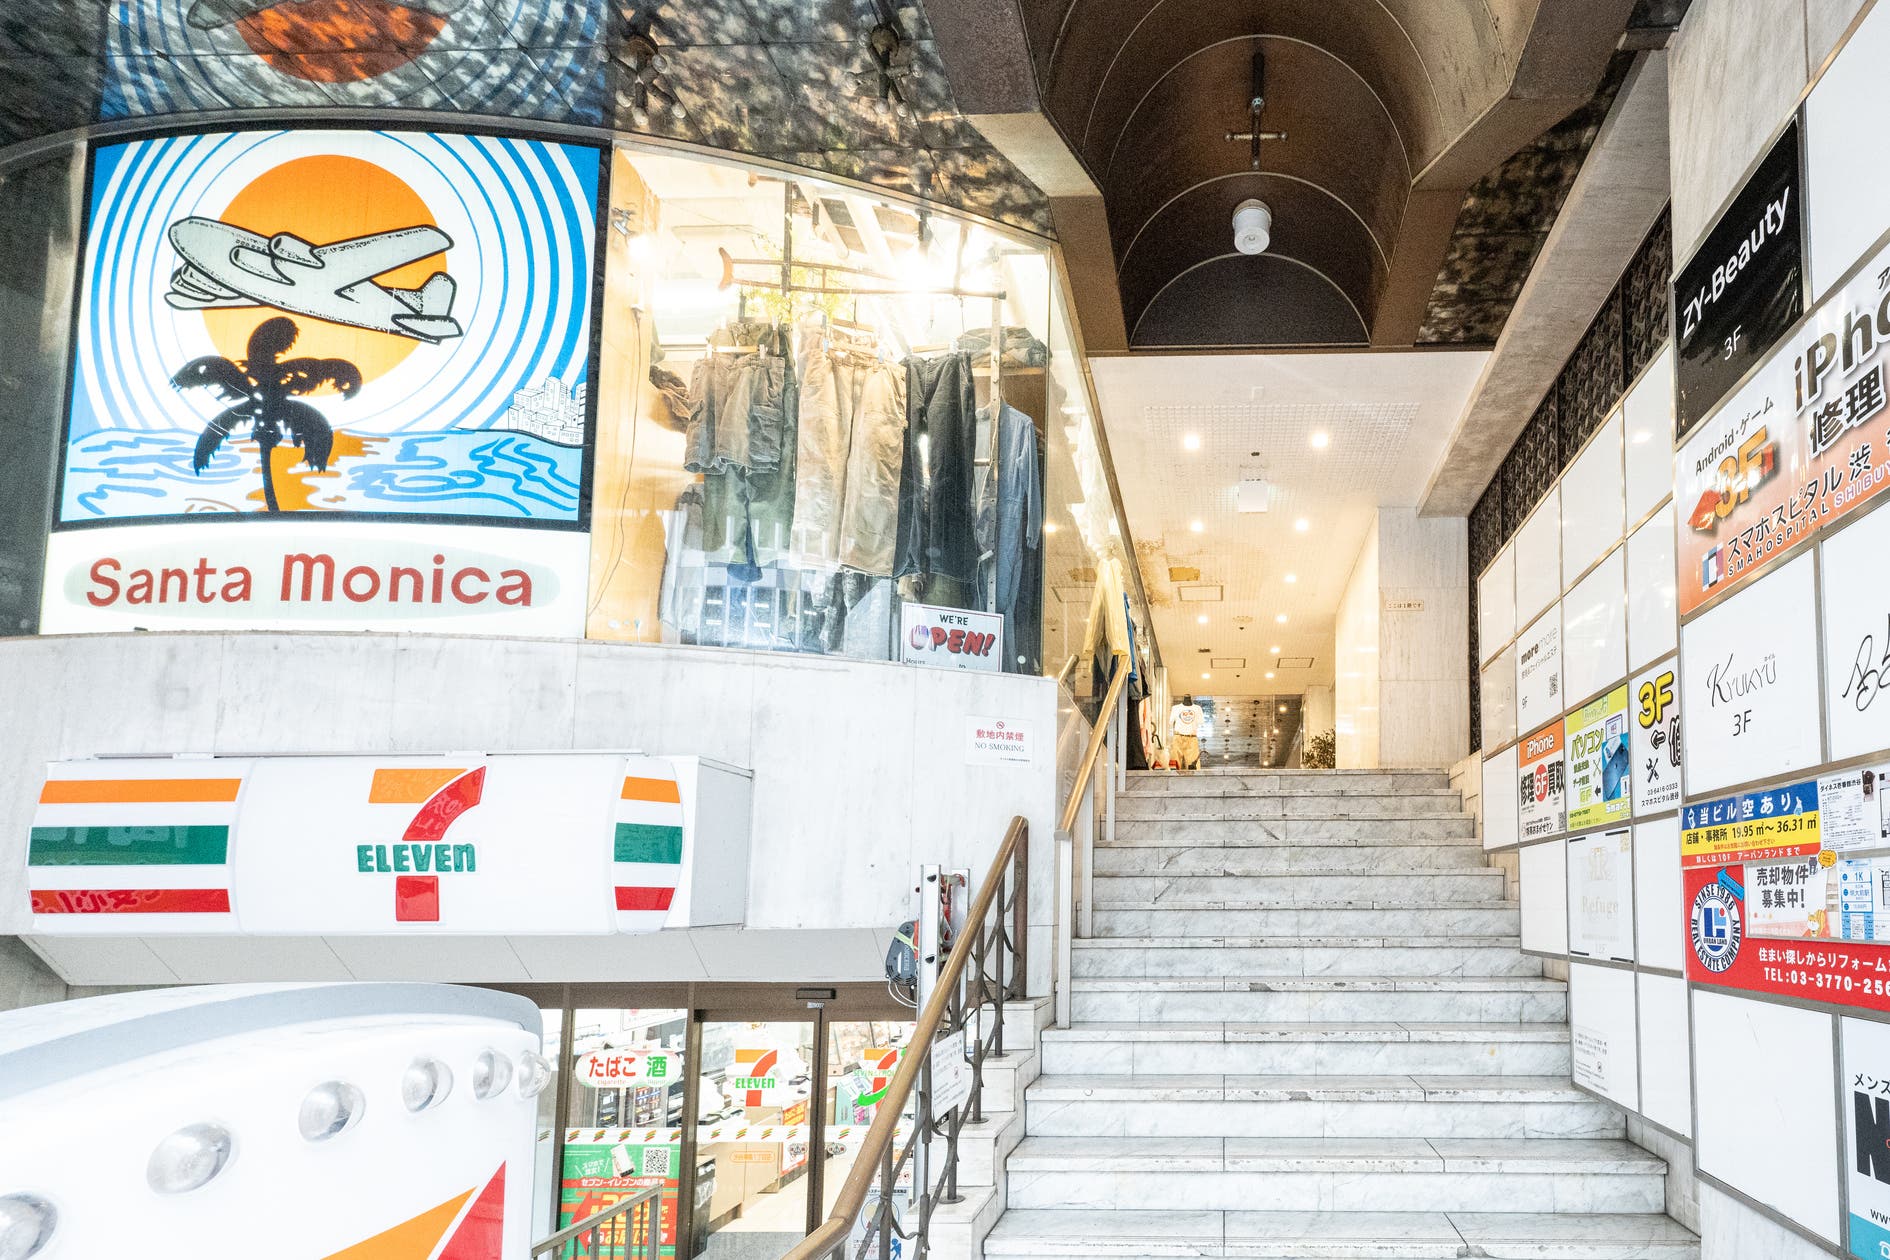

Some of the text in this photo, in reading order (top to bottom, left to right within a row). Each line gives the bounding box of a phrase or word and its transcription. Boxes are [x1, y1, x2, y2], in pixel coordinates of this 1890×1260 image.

[1682, 186, 1790, 340] ZY-Beauty
[1724, 325, 1742, 361] 3F
[1809, 364, 1883, 455] 修理
[1714, 424, 1767, 519] 3F
[1727, 501, 1830, 577] SMAHOSPITAL
[87, 556, 252, 608] Santa
[939, 614, 969, 626] WE'RE
[1638, 670, 1675, 730] 3F
[1733, 709, 1753, 737] 3F
[989, 743, 1025, 752] SMOKING
[1527, 733, 1555, 760] iPhone
[1535, 772, 1548, 797] 6F
[1777, 818, 1803, 833] 36.31
[1756, 864, 1809, 887] 売却物件
[1758, 947, 1890, 973] 住まい探しからリフォーム
[589, 1055, 667, 1078] たばこ 酒
